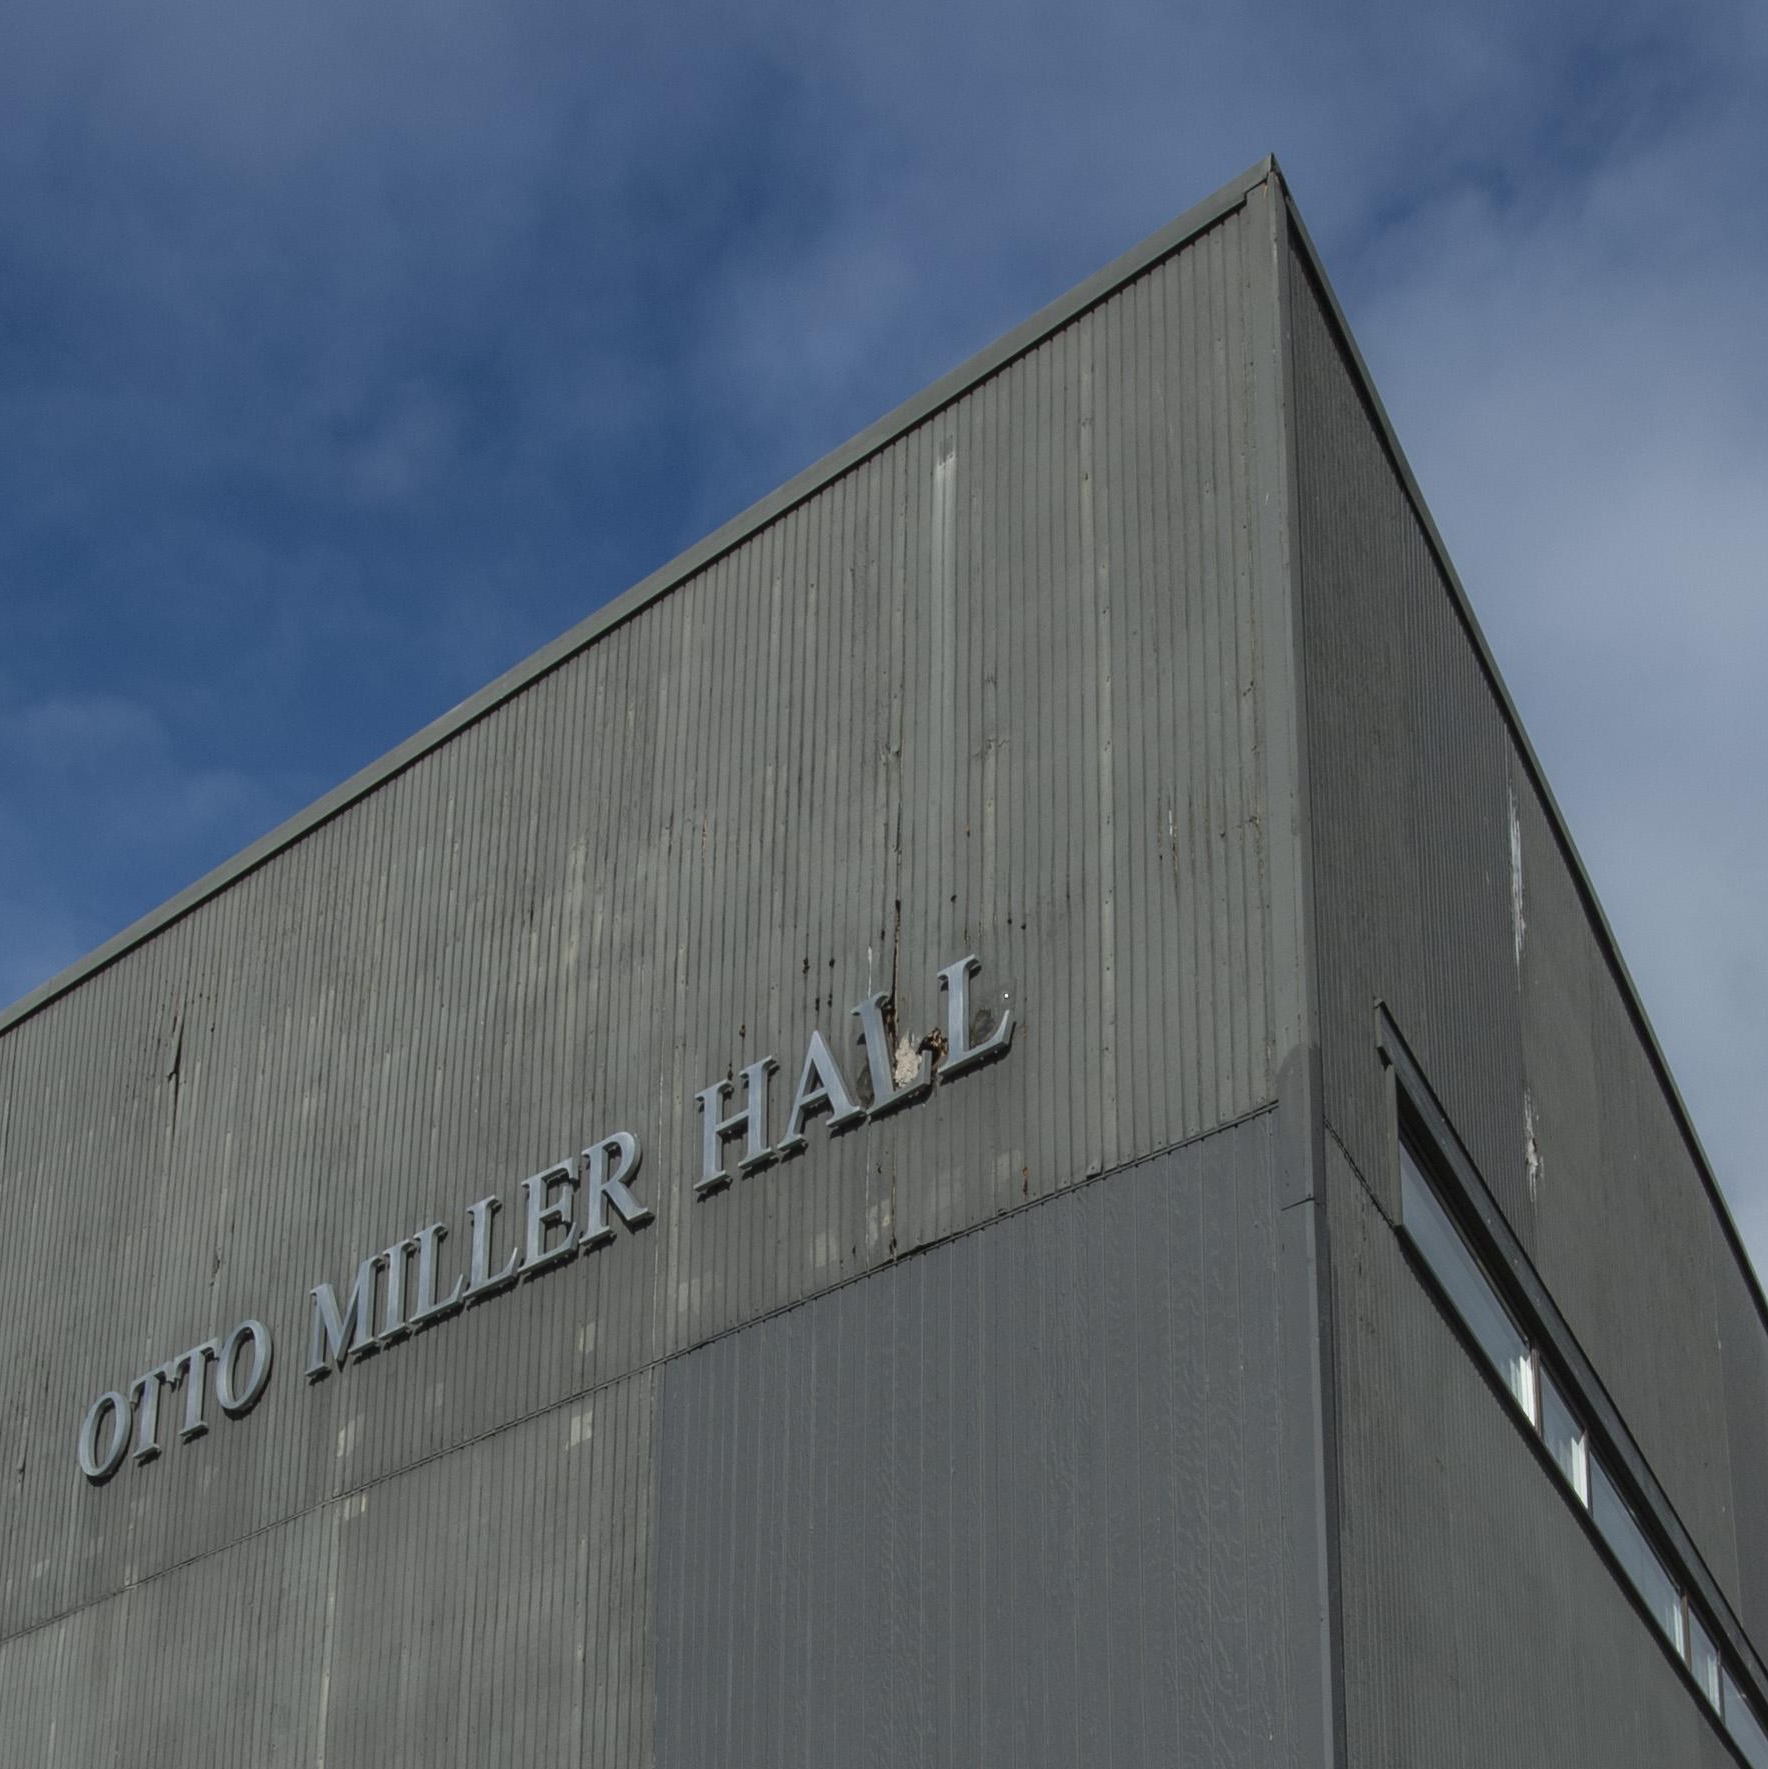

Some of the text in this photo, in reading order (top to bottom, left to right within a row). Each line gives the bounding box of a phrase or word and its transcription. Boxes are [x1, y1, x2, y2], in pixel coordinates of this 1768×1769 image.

[80, 954, 1015, 1479] OTTO MILLER HALL
